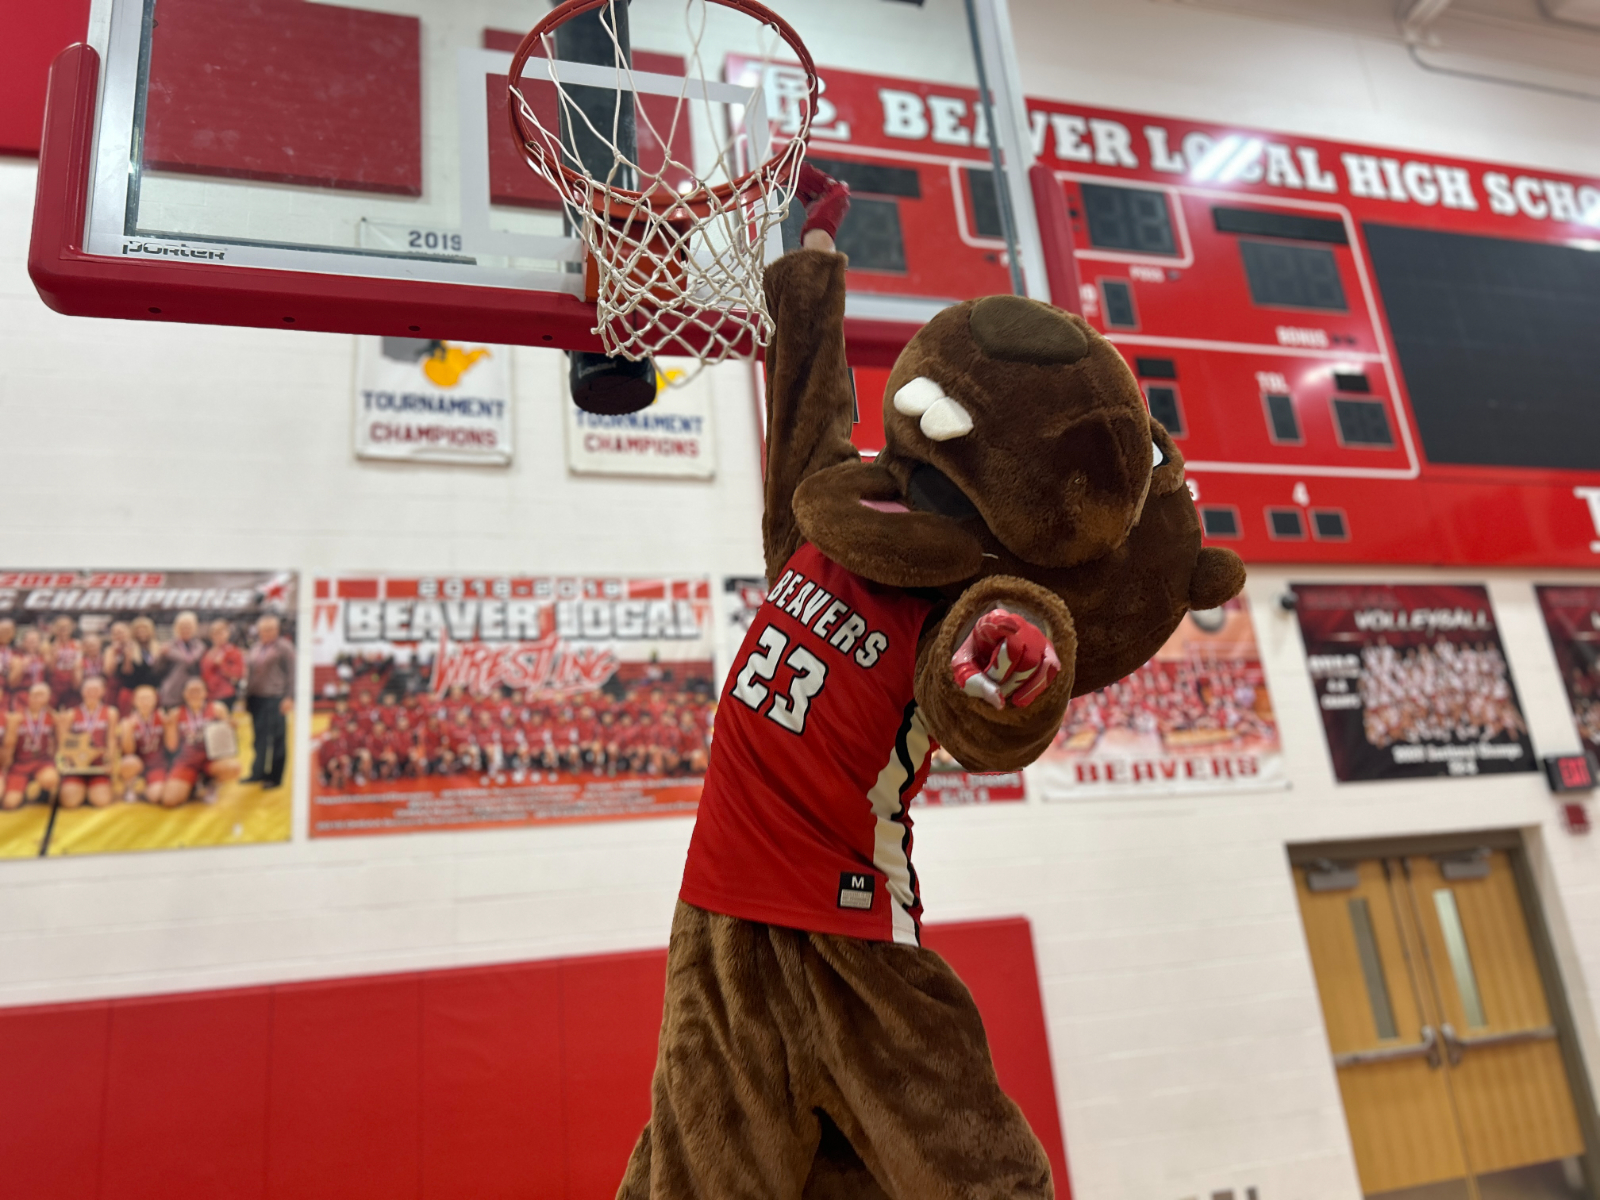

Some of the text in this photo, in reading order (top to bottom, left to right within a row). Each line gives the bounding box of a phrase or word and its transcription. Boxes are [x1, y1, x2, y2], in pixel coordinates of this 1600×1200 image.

[1340, 153, 1478, 211] HIGH
[408, 230, 462, 252] 2019
[362, 390, 505, 419] TOURNAMENT
[575, 408, 705, 434] TOURNAMENT
[369, 422, 498, 448] CHAMPIONS
[584, 433, 699, 458] CHAMPIONS
[1292, 481, 1310, 506] 4
[24, 587, 252, 611] CHAMPIONS
[345, 601, 539, 642] BEAVER
[766, 568, 889, 669] BEAVERS
[1354, 608, 1490, 633] VOLLEYBALL
[729, 623, 829, 736] 23
[1075, 756, 1258, 784] BEAVERS
[851, 875, 865, 889] M
